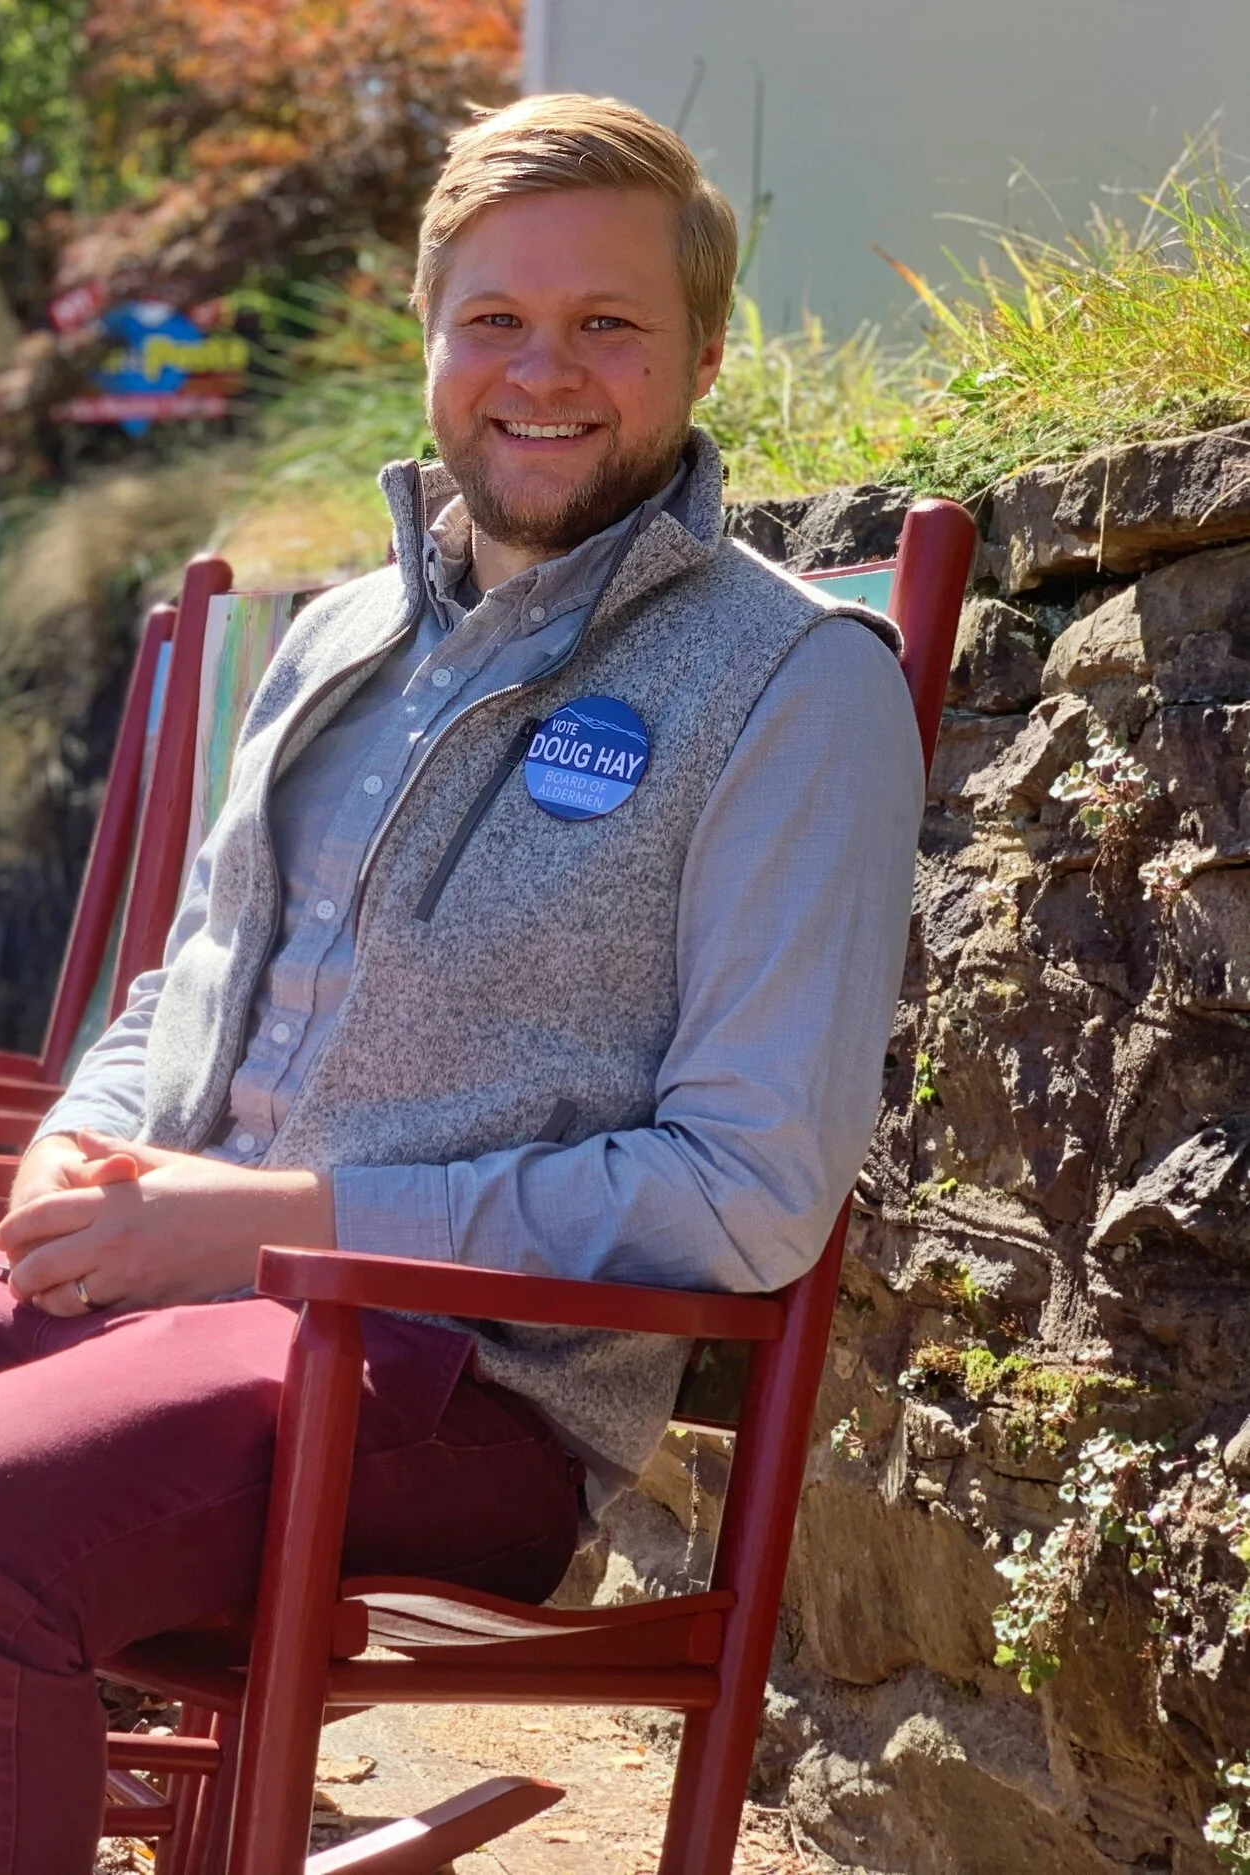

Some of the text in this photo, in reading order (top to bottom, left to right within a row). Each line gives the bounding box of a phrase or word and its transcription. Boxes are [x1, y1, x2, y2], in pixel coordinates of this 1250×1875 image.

[551, 719, 580, 736] VOTE
[527, 733, 645, 779] DOUG HAY
[545, 771, 608, 794] BOARD OF
[537, 784, 604, 809] ALDERMEN
